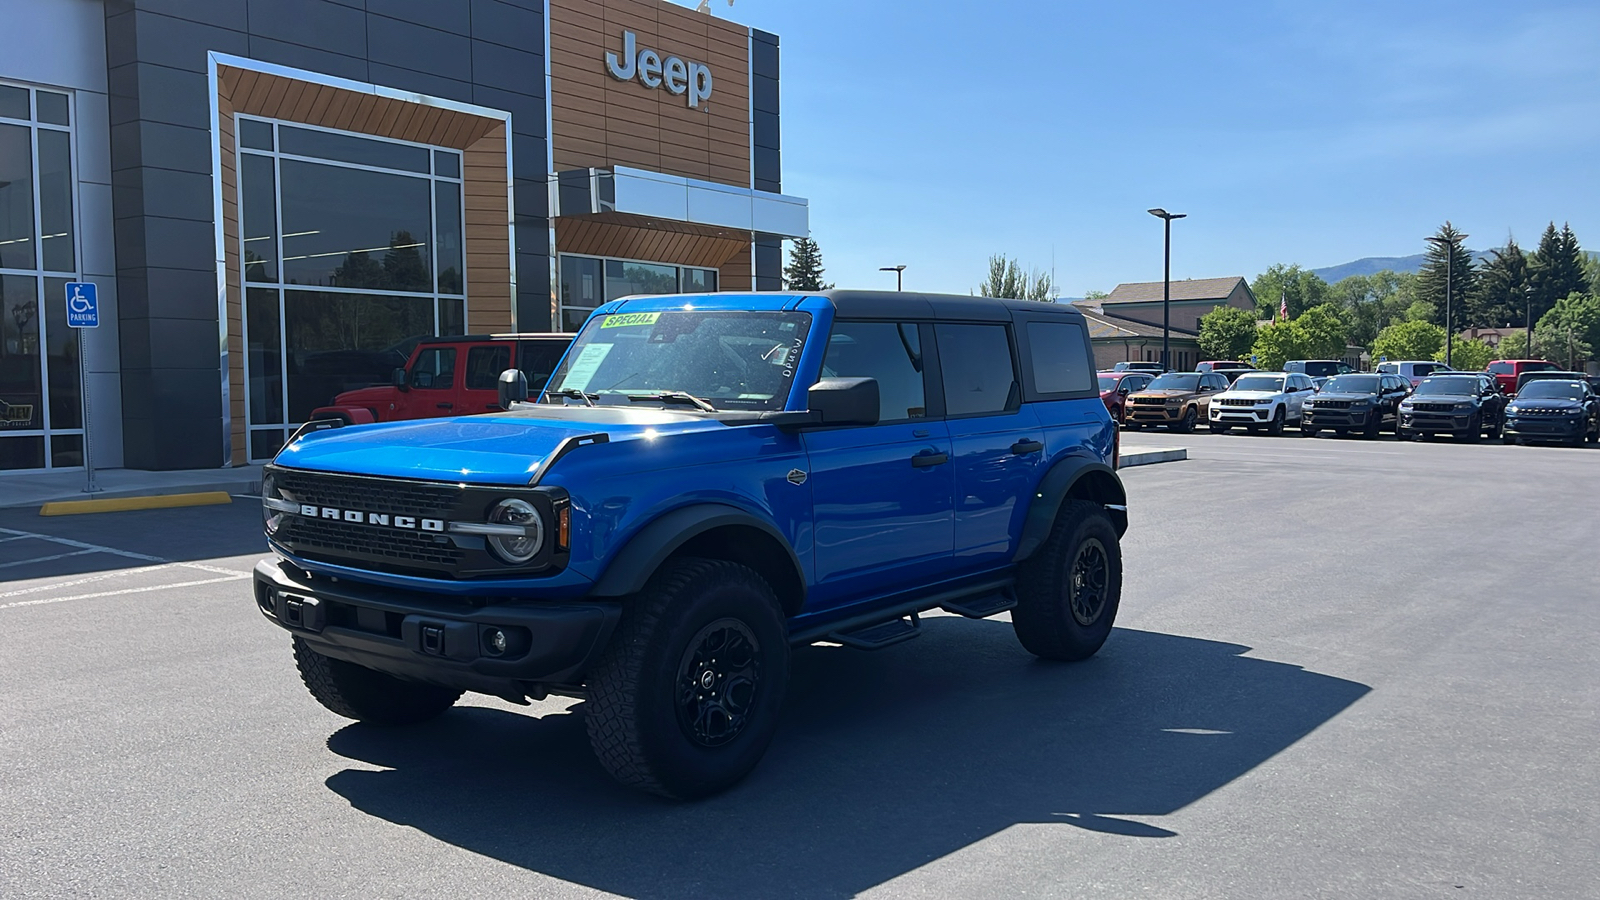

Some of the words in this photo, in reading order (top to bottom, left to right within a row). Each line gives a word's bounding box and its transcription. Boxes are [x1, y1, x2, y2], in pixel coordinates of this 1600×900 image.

[604, 29, 713, 110] Jeep
[70, 313, 96, 322] PARKING
[605, 313, 654, 327] SPECIAL
[301, 504, 444, 532] BRONCO
